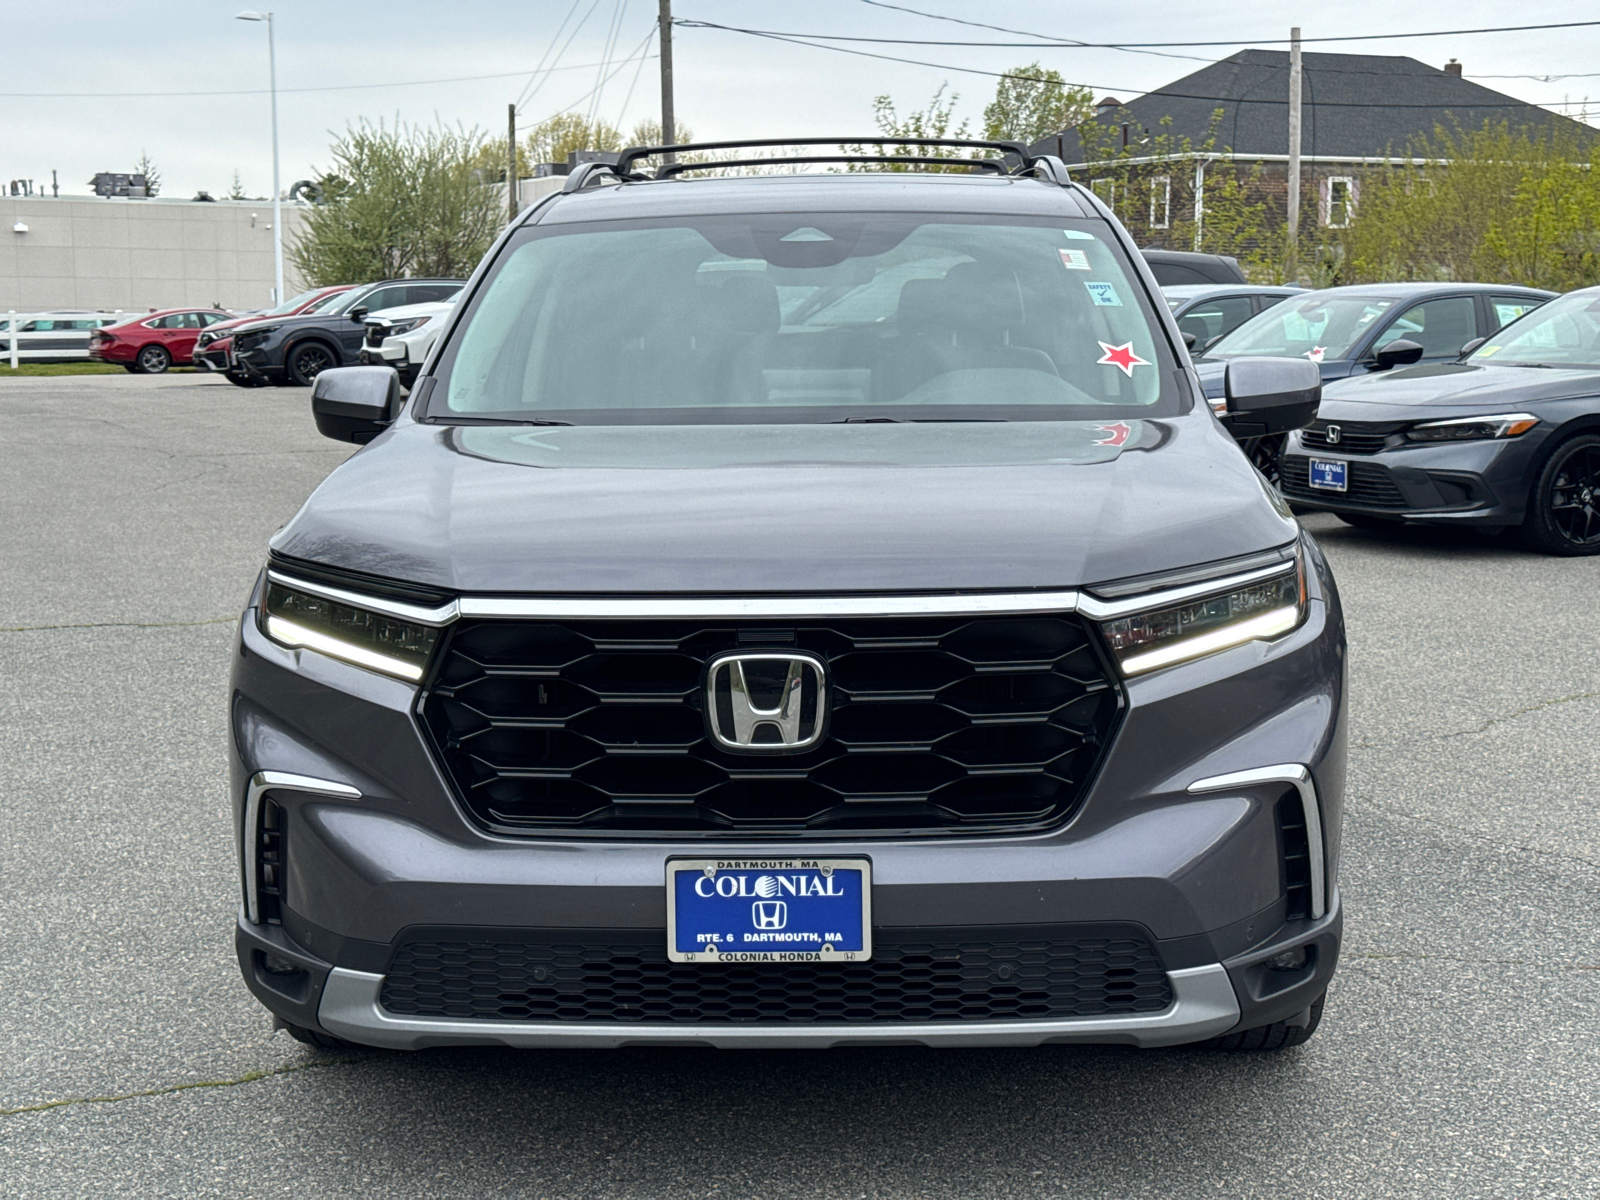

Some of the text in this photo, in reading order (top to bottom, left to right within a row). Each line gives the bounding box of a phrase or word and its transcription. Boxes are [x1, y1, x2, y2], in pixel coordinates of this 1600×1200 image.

[717, 861, 797, 869] DARTMOUTH,
[694, 875, 844, 898] COLONIAL
[697, 932, 843, 943] RTE. 6 DARTMOUTH, MA
[718, 952, 821, 962] COLONIAL HONDA
